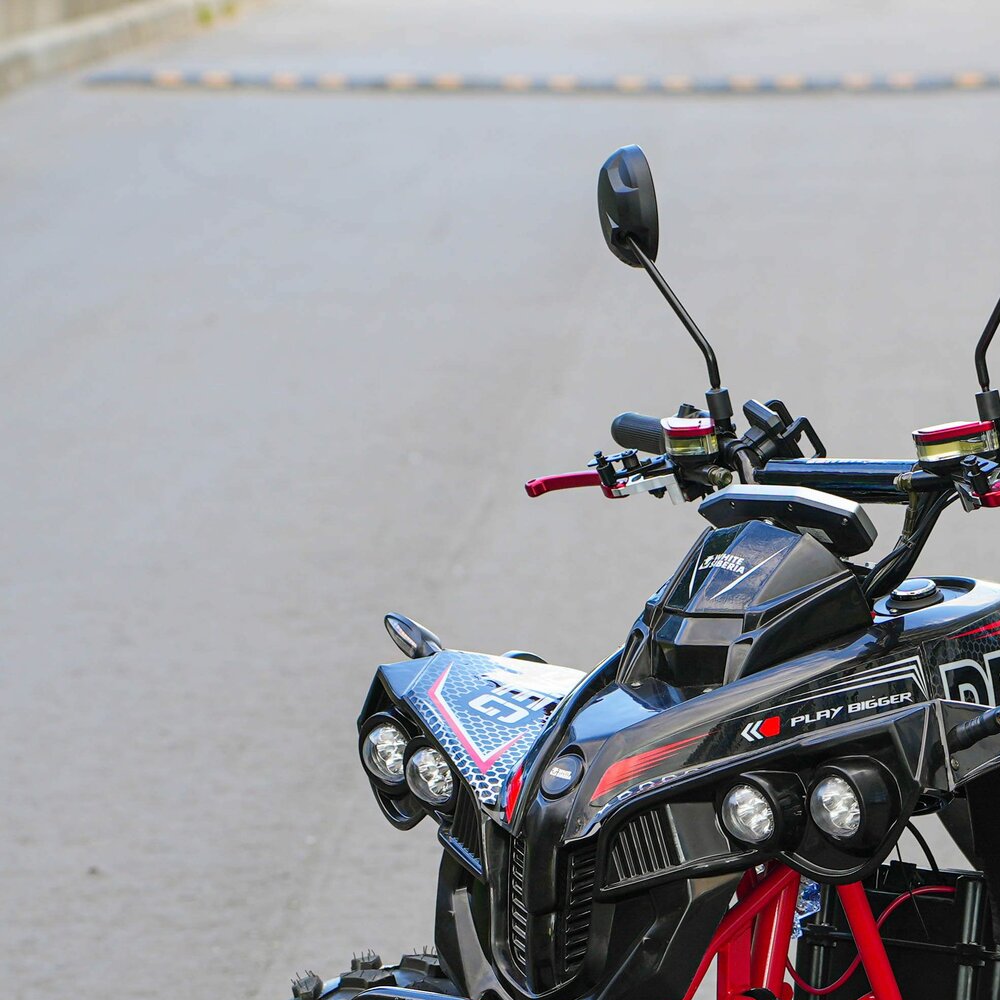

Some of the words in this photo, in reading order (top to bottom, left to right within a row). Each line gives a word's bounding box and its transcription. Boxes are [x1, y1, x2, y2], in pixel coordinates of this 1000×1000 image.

[713, 553, 745, 565] WHITE
[790, 706, 844, 728] PLAY
[848, 692, 914, 714] BIGGER
